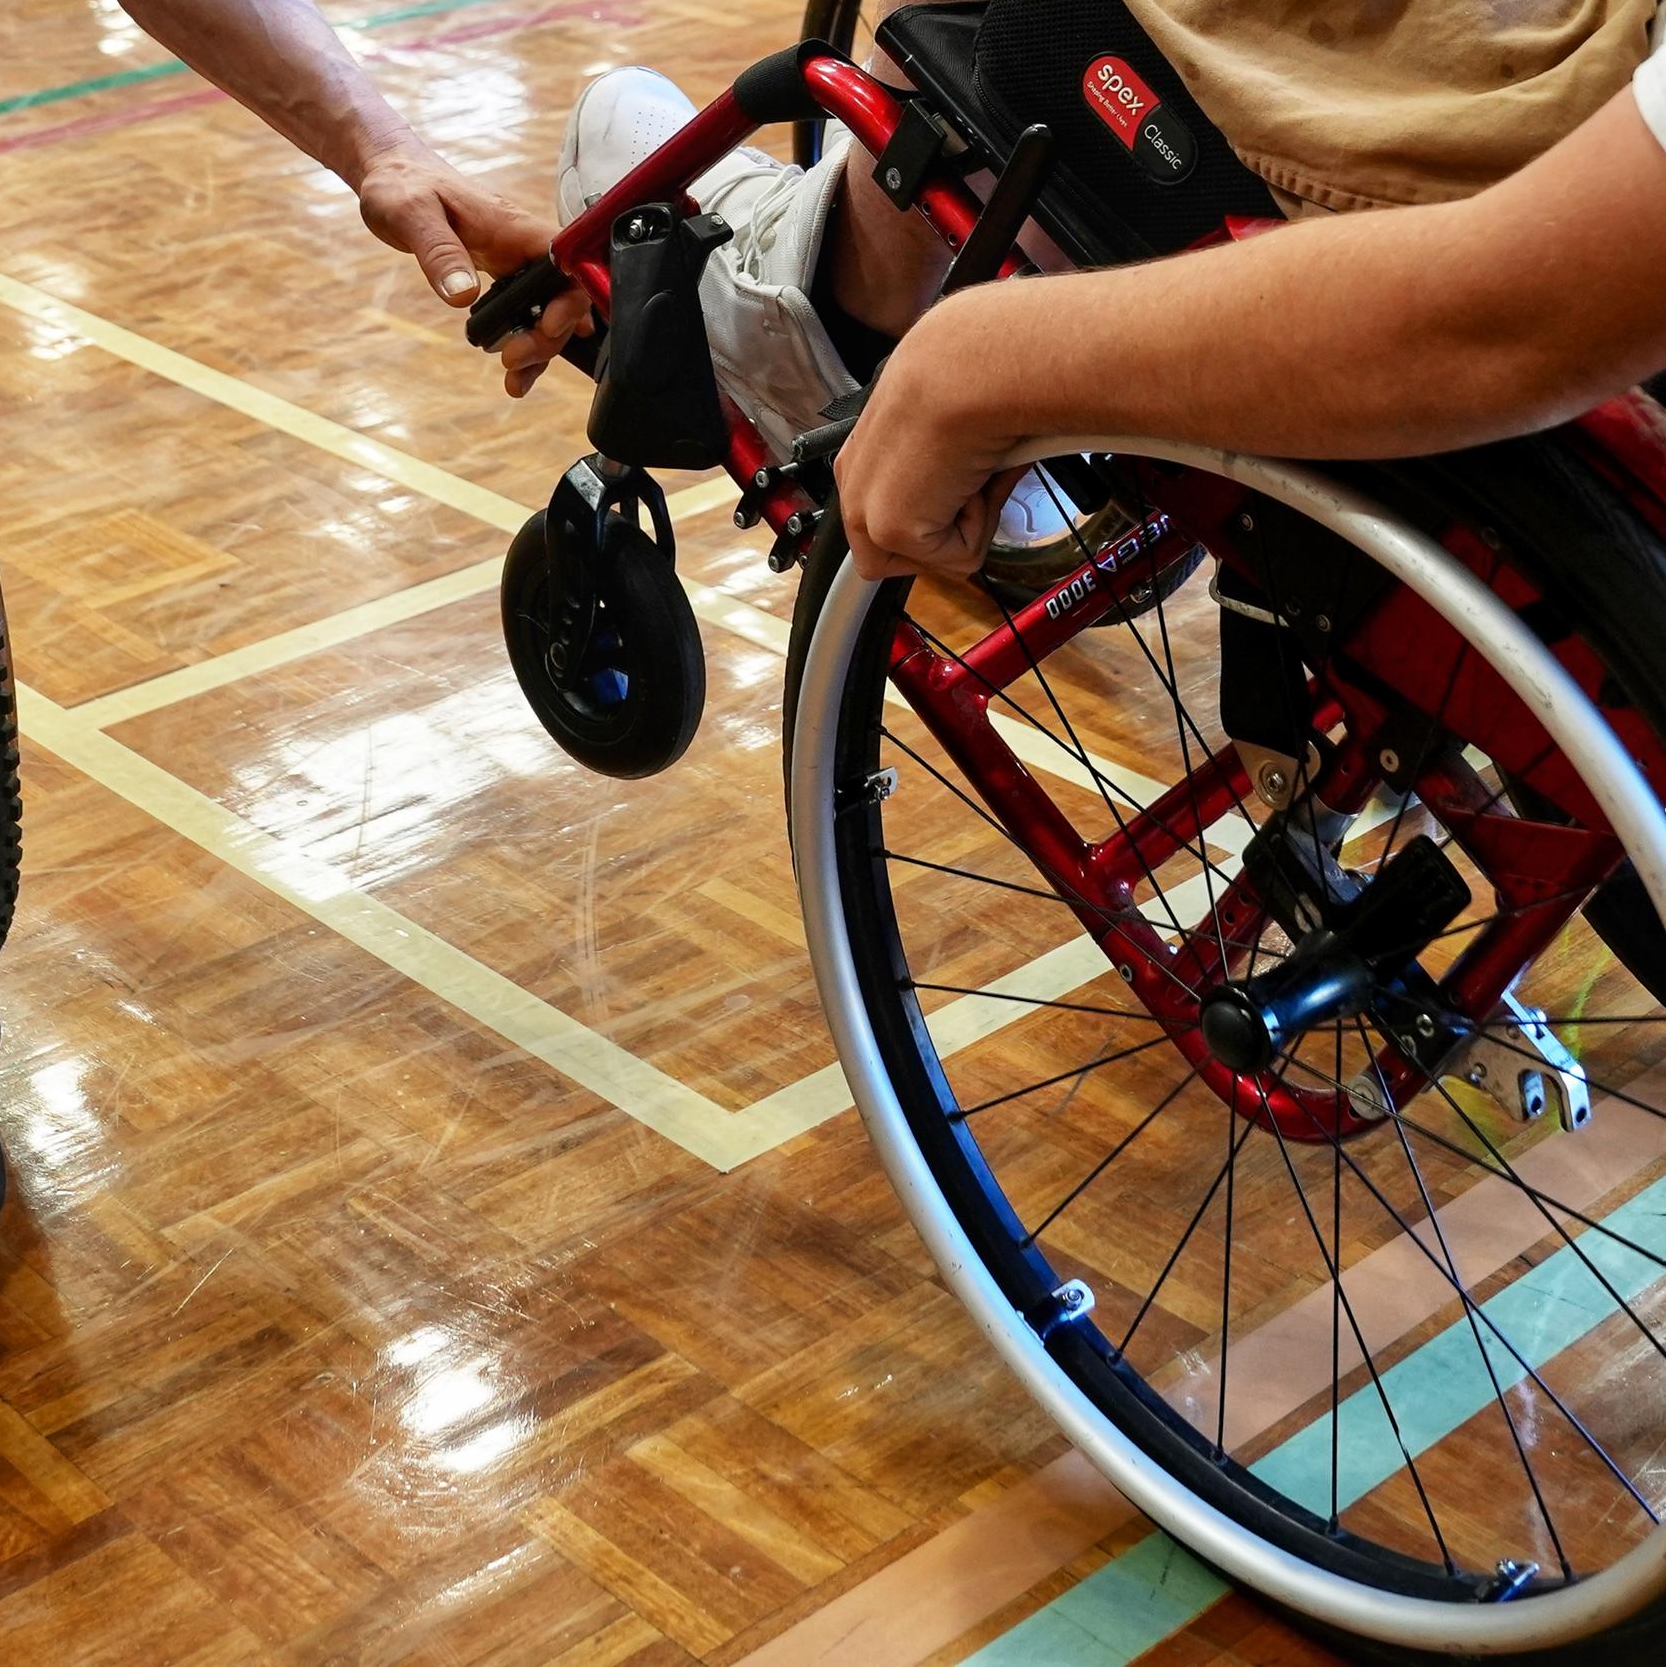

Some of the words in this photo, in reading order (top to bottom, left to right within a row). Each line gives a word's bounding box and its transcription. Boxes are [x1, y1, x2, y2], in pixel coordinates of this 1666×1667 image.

[1097, 64, 1145, 116] spex
[1144, 124, 1182, 170] Classic
[1045, 570, 1097, 620] 3000
